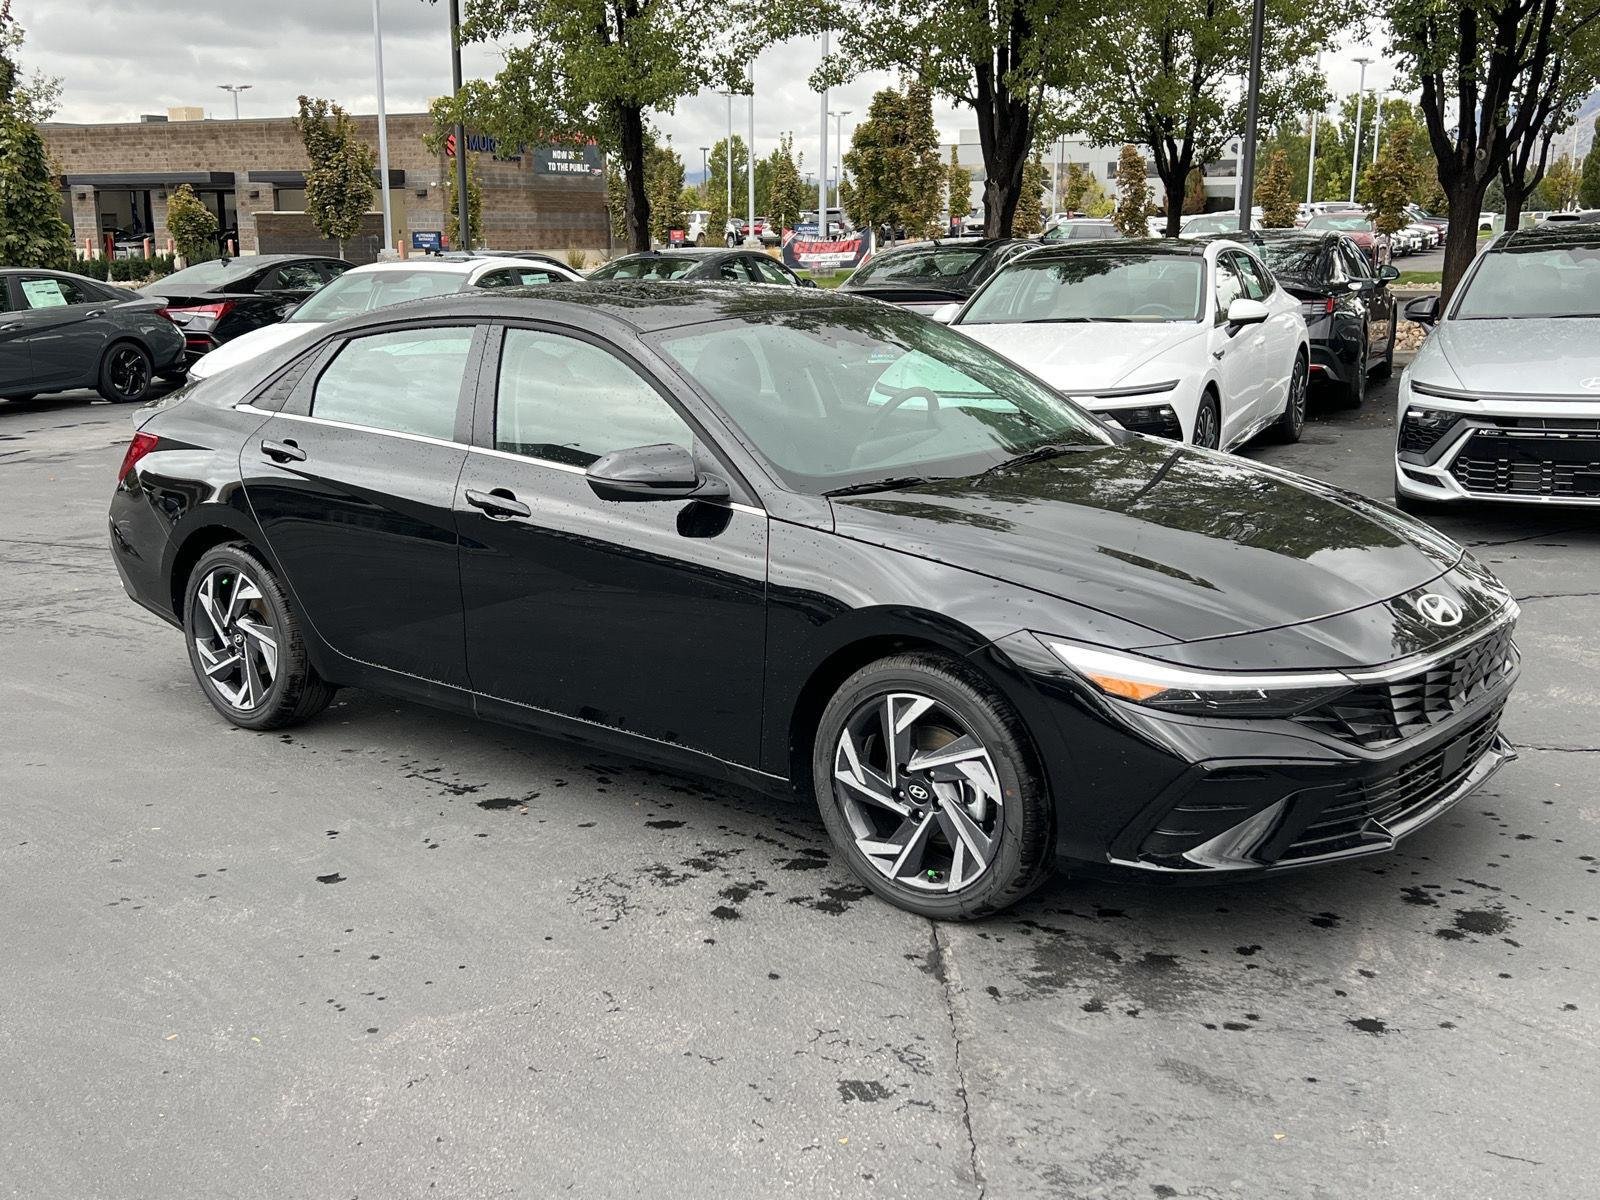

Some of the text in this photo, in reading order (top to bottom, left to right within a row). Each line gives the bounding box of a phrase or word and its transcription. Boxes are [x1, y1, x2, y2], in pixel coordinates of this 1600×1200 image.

[552, 150, 567, 159] NOW
[548, 162, 590, 173] TO THE PUBLIC
[793, 240, 861, 253] CLOSEOUT
